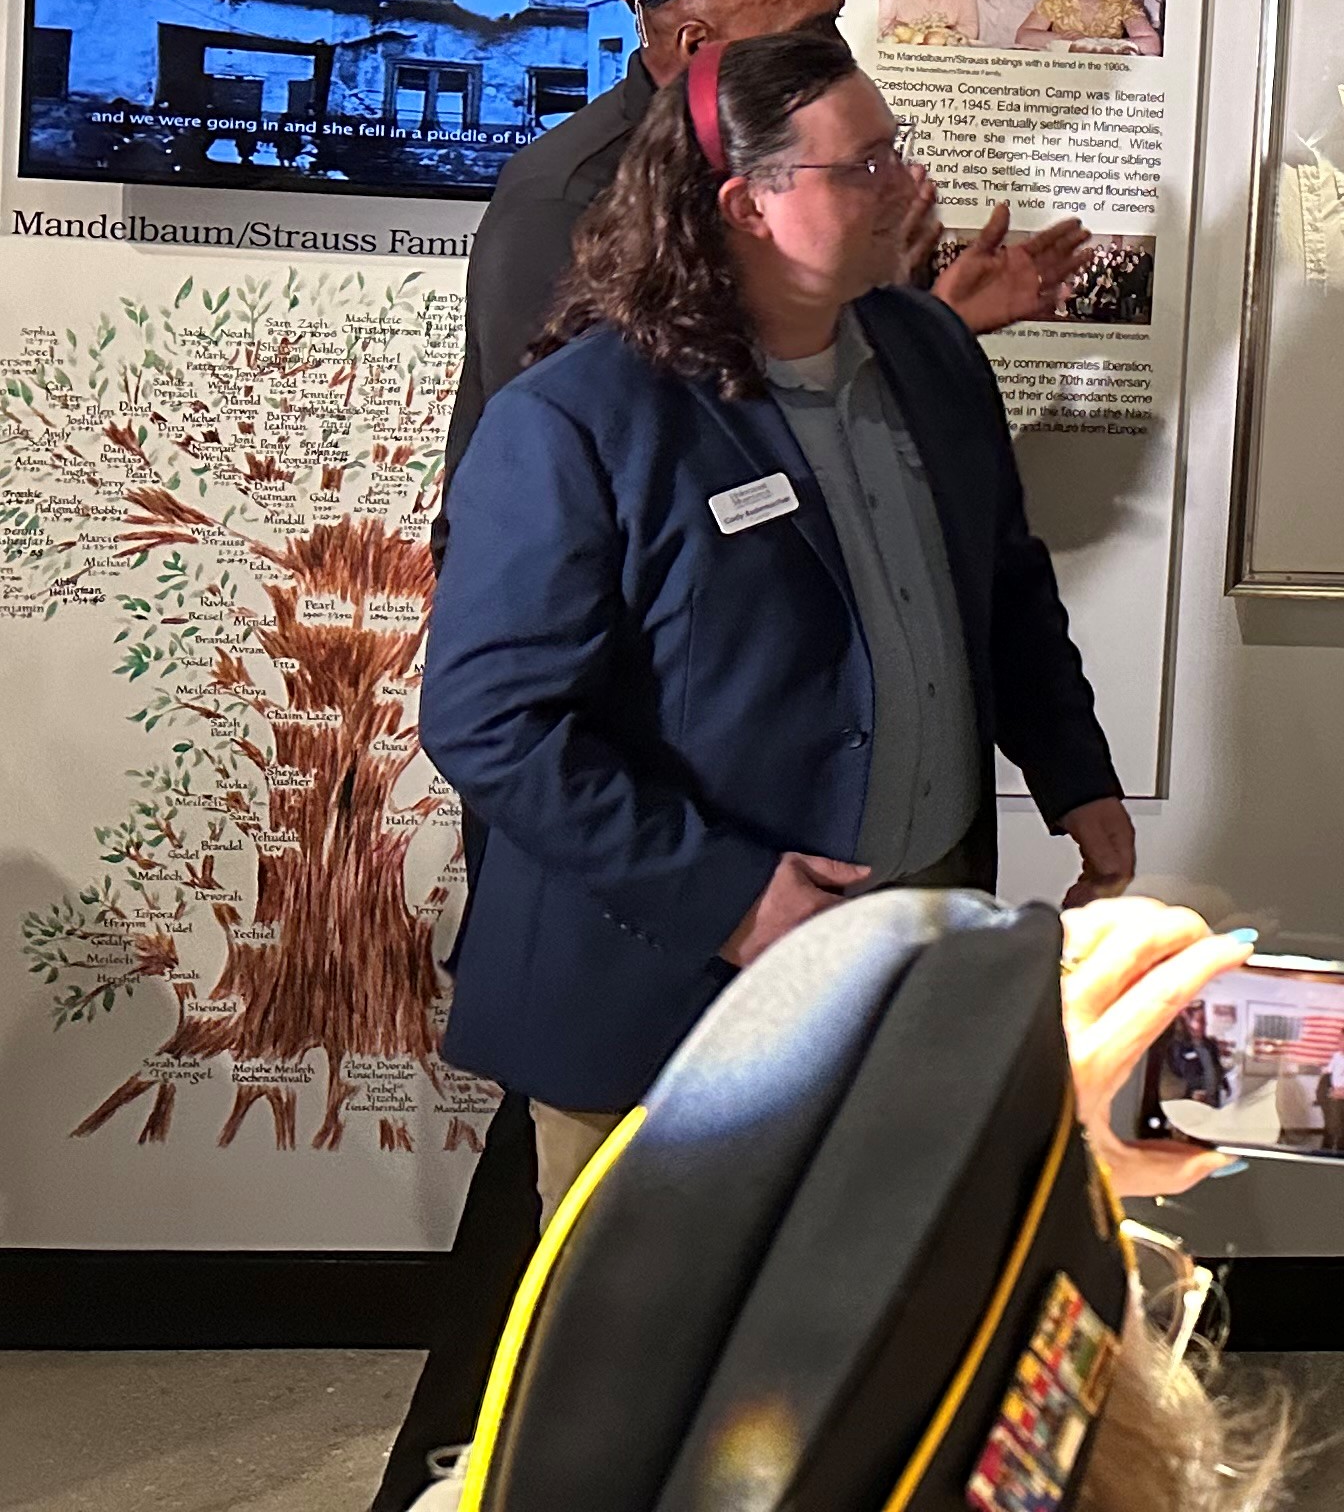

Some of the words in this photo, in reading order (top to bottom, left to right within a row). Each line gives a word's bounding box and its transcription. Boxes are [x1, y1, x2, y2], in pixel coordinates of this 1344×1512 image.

[958, 82, 1040, 97] Concentration
[1046, 86, 1081, 101] Camp
[1086, 91, 1110, 101] was
[1115, 89, 1165, 103] liberated
[889, 96, 937, 111] January
[997, 100, 1020, 113] Eda
[1024, 102, 1089, 117] immigrated
[1106, 105, 1123, 118] the
[1127, 106, 1164, 119] United
[92, 110, 124, 124] and
[130, 115, 155, 126] we
[159, 116, 201, 128] were
[207, 116, 257, 133] going
[263, 117, 279, 131] in
[284, 119, 317, 133] and
[323, 121, 353, 135] she
[359, 122, 385, 137] fell
[390, 125, 406, 138] in
[412, 129, 422, 139] a
[427, 127, 487, 144] puddle
[492, 130, 512, 143] of
[515, 131, 539, 145] bl
[11, 209, 377, 254] Mandelbaum/Strauss
[389, 228, 477, 258] Fami
[182, 412, 221, 423] Michael
[254, 482, 285, 492] David
[310, 493, 340, 503] Golda
[305, 600, 335, 610] Pearl
[234, 616, 276, 627] Mendel
[233, 685, 267, 696] Chaya
[195, 890, 243, 902] Devorah
